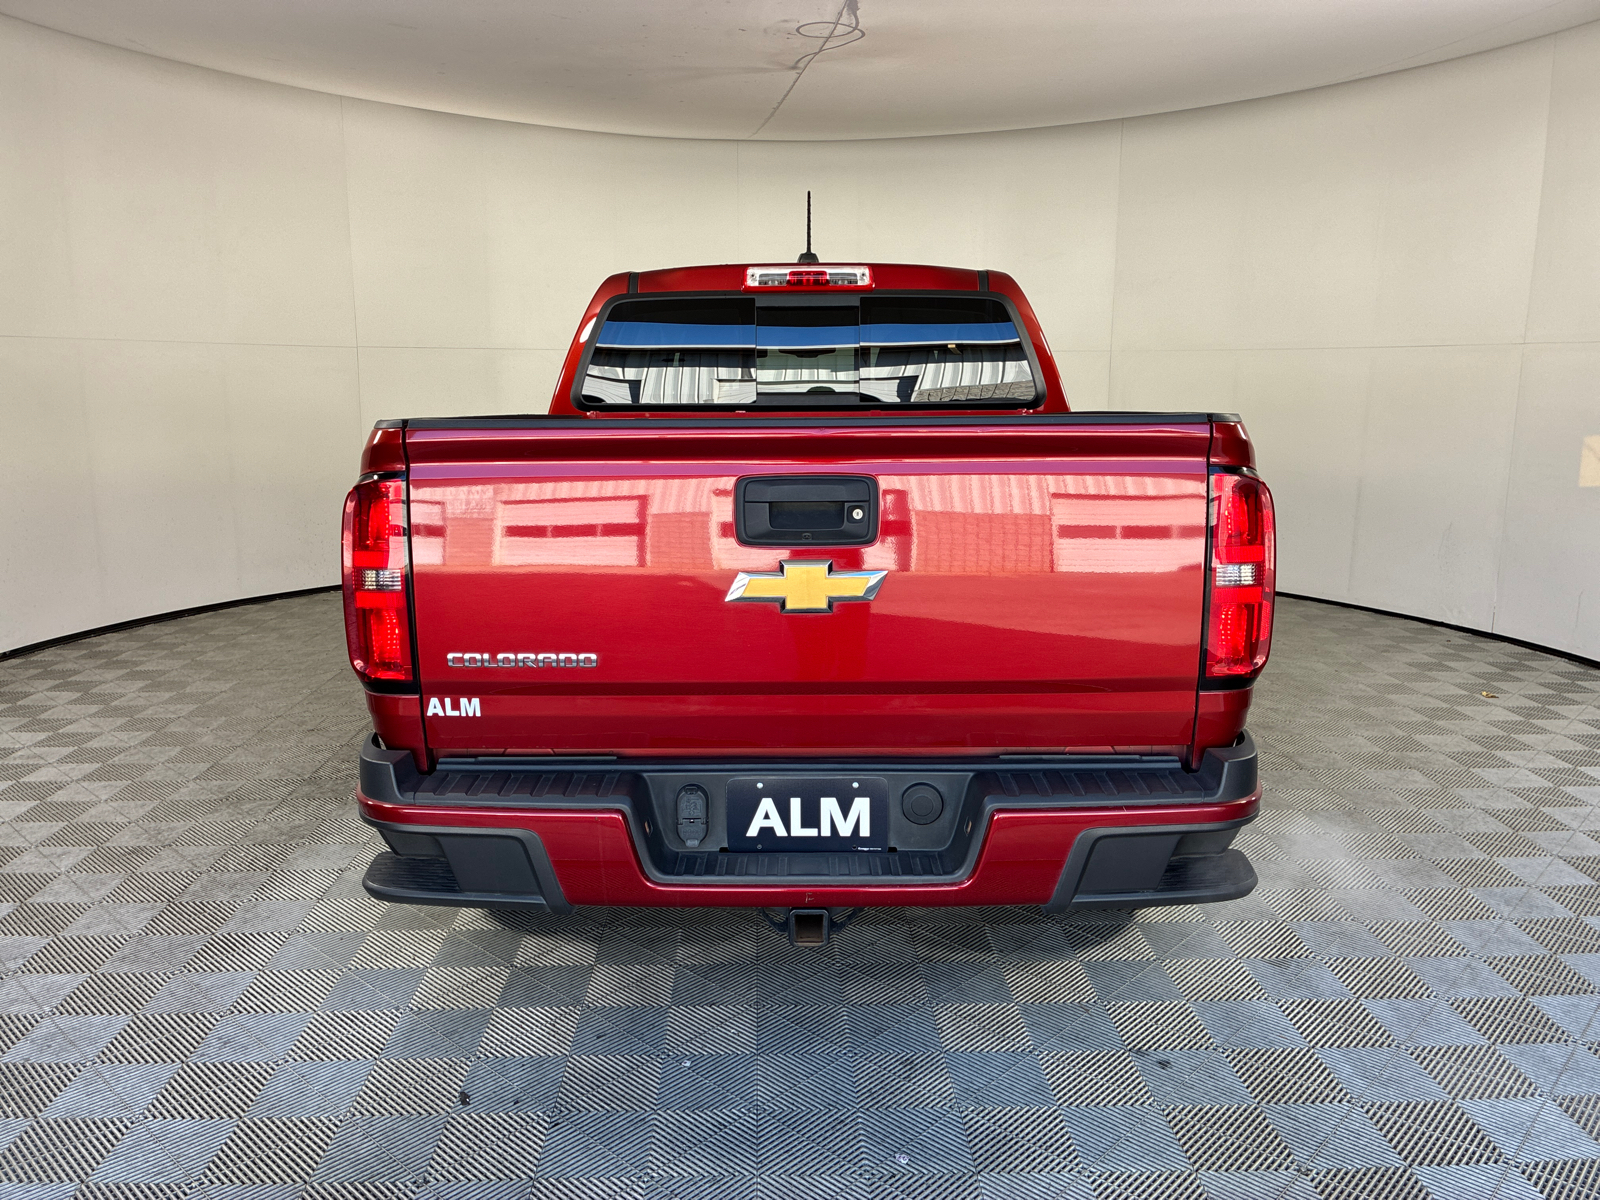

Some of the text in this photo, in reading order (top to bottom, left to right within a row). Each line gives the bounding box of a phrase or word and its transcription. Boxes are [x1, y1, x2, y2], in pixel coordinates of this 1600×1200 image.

[446, 652, 598, 668] COLORADO
[426, 697, 481, 717] ALM
[745, 797, 870, 837] ALM
